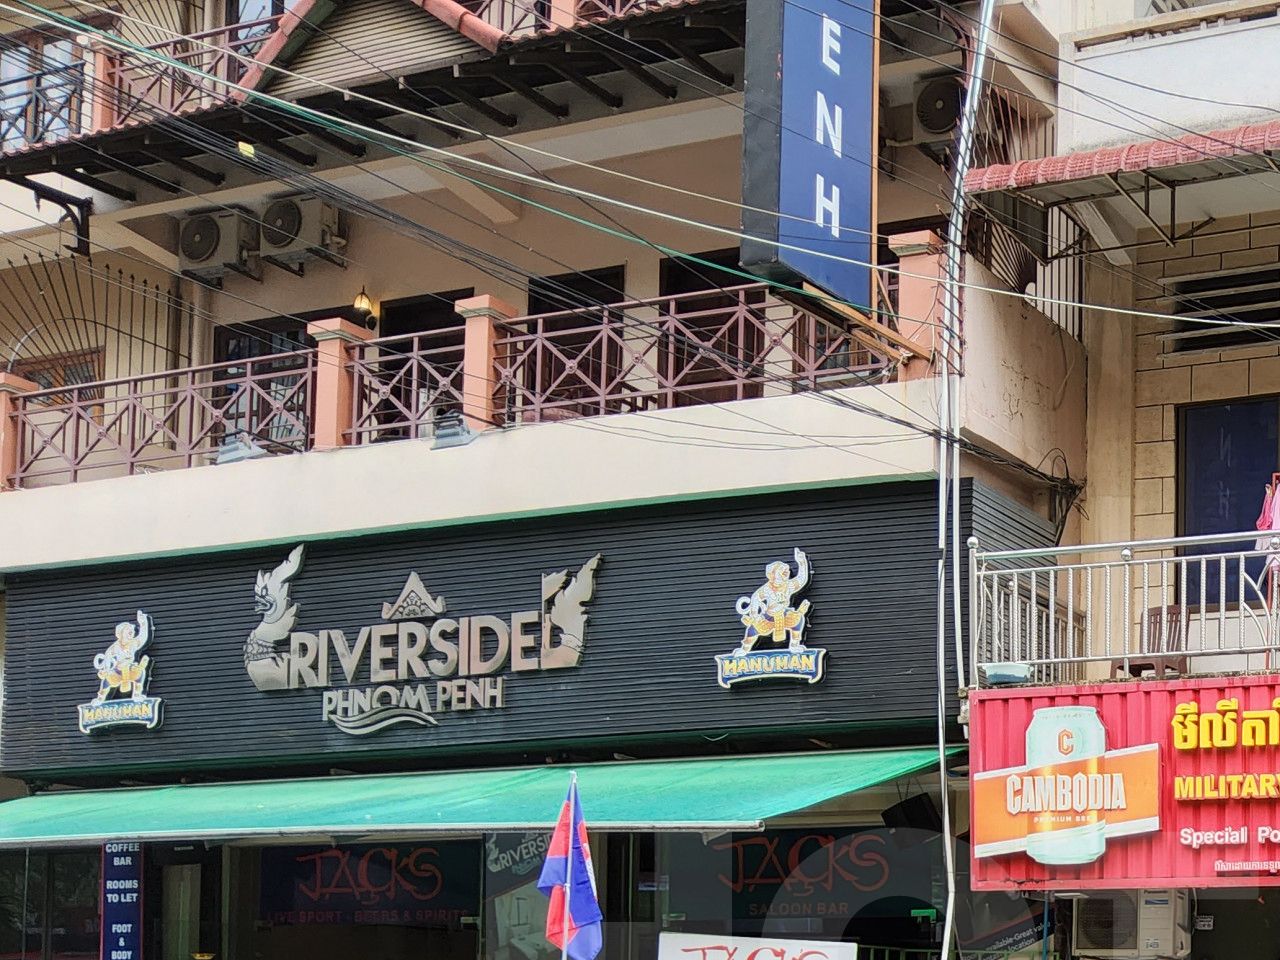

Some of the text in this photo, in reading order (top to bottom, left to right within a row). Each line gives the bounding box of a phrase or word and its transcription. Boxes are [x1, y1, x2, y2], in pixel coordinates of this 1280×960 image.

[290, 610, 539, 688] RIVERSIDE
[722, 655, 815, 677] HANUMAN
[323, 675, 505, 721] PHNOM PENH
[82, 702, 153, 726] HANUMAN
[1006, 771, 1127, 815] CAMBODIA
[1179, 824, 1248, 848] Special
[105, 842, 140, 853] COFFEE
[113, 857, 132, 866] BAR
[106, 880, 138, 890] ROOMS
[106, 893, 138, 903] TO LET
[749, 902, 849, 917] SALOON BAR
[112, 924, 132, 933] FOOT
[118, 938, 125, 947] &
[111, 951, 132, 960] BODY
